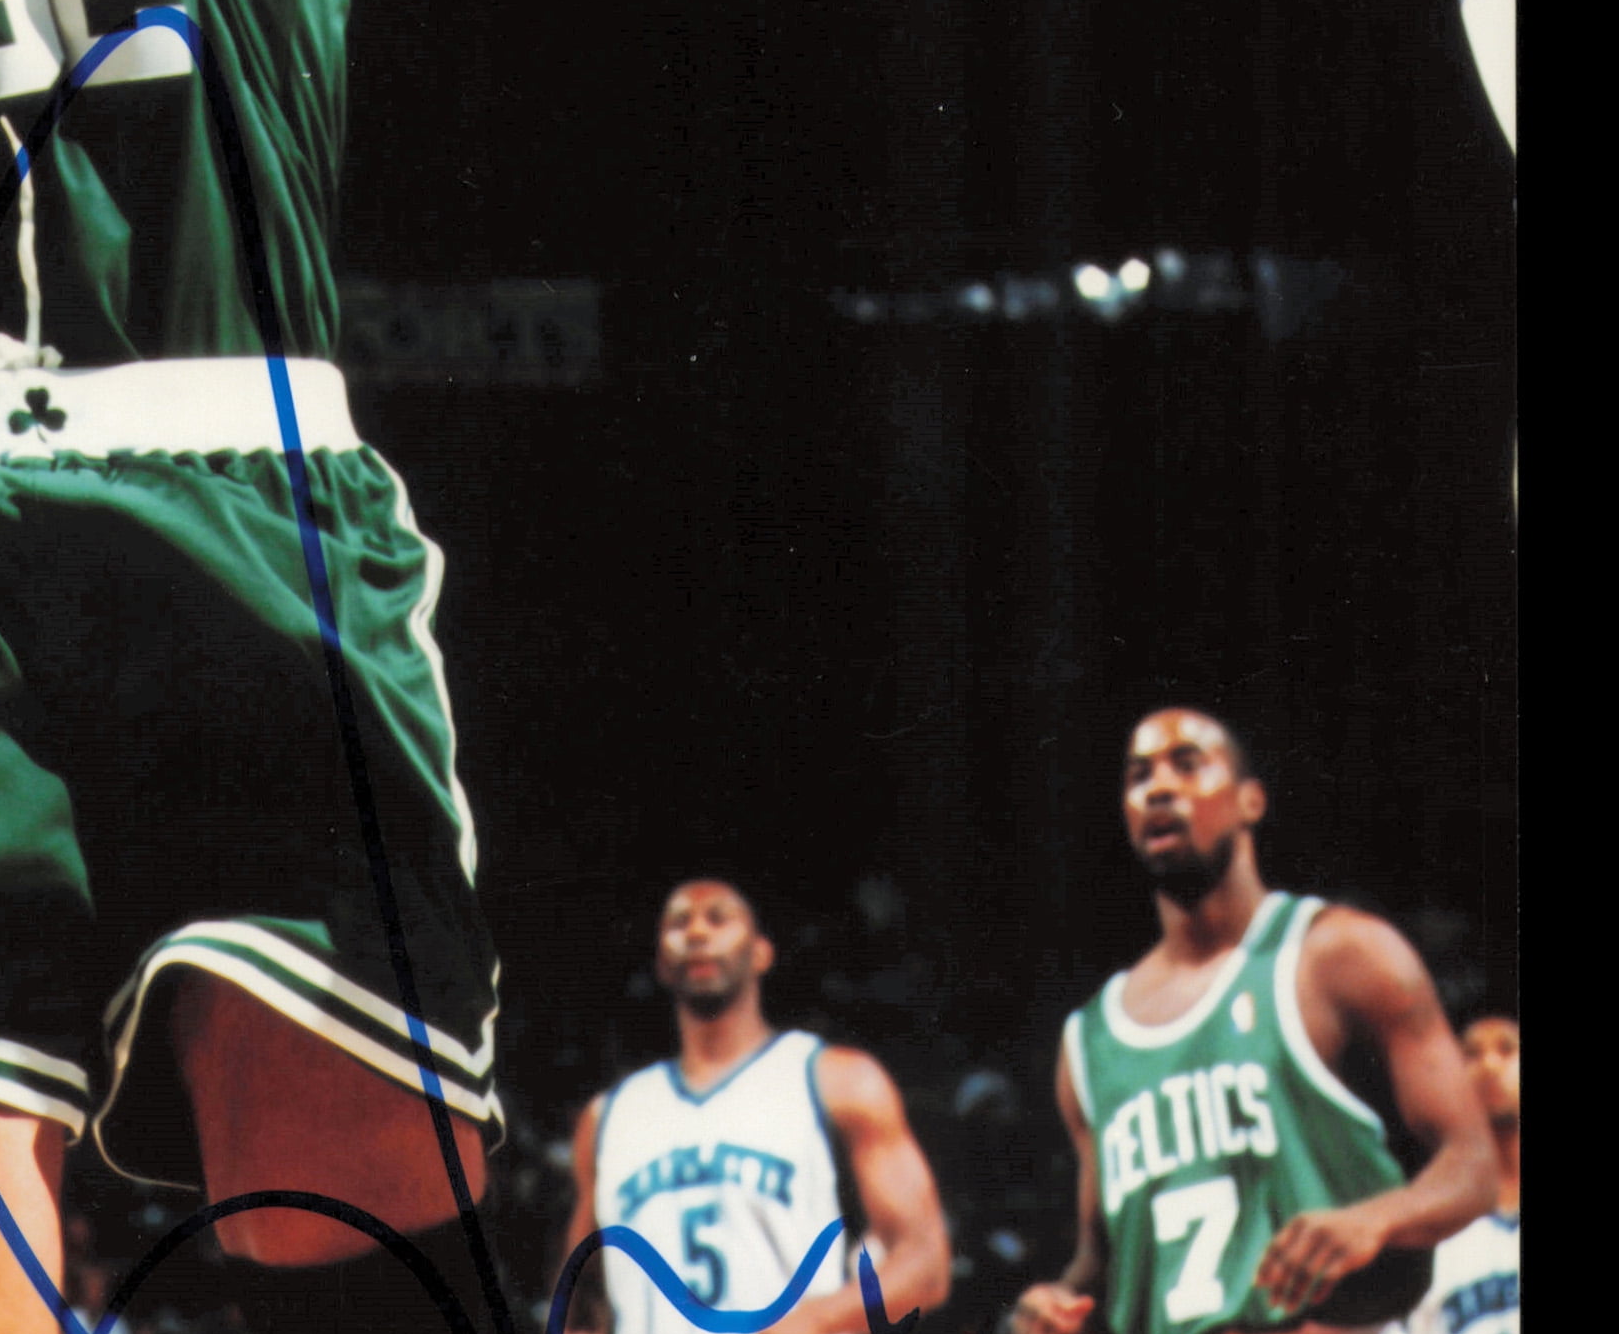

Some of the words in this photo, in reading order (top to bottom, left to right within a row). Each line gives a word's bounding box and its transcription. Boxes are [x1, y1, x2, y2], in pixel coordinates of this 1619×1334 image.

[1103, 1063, 1278, 1217] CELTICS
[680, 1201, 728, 1311] 5
[1150, 1174, 1240, 1325] 7
